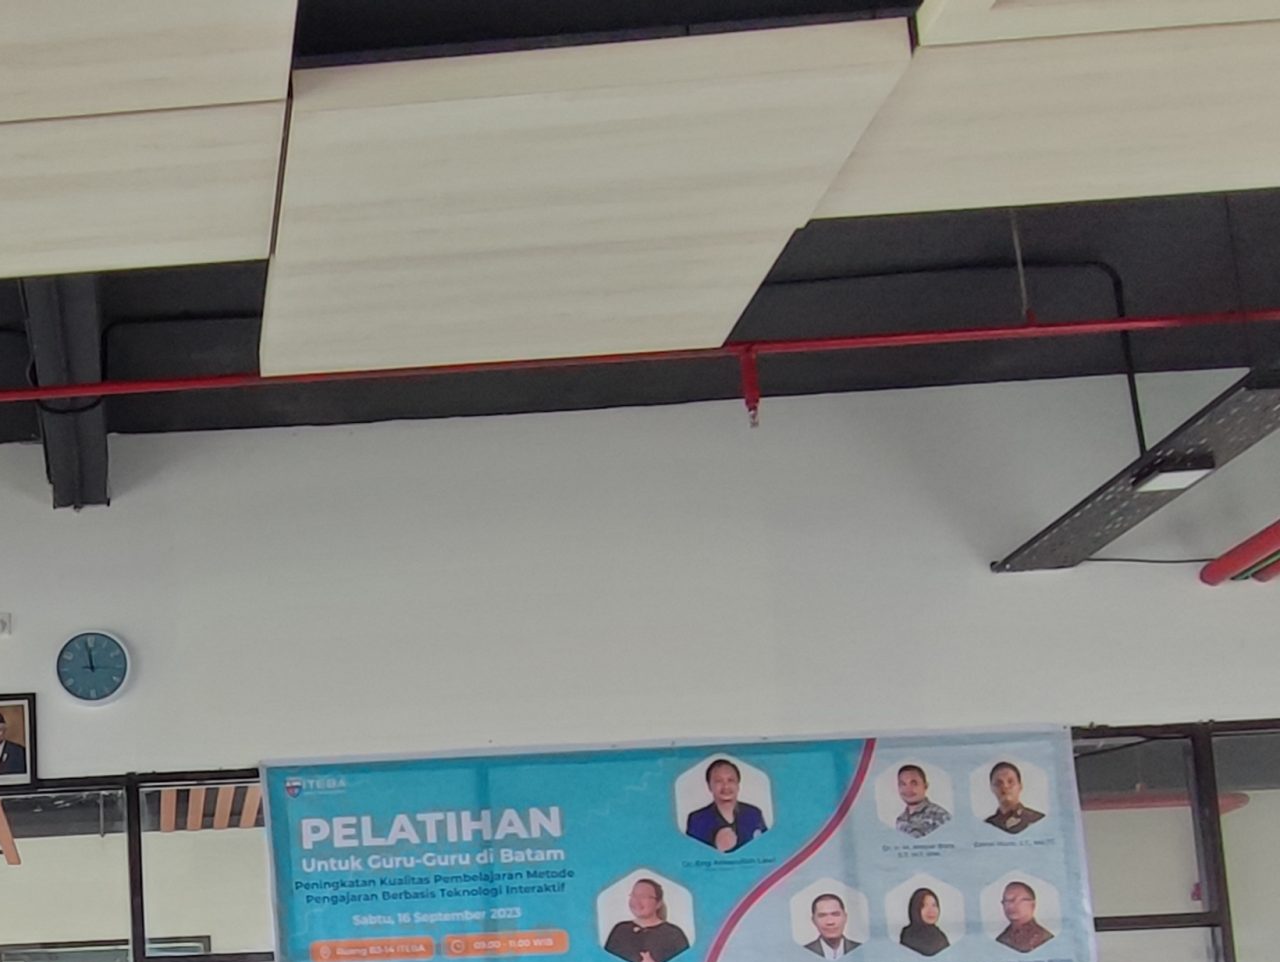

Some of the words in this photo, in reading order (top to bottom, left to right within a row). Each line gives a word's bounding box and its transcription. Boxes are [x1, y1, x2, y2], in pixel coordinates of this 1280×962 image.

[301, 806, 563, 850] PELATIHAN
[302, 855, 362, 873] Untuk
[367, 851, 470, 869] Guru-Guru
[475, 848, 494, 864] di
[500, 847, 565, 863] Batam
[294, 877, 377, 892] Peningkatan
[380, 873, 431, 887] Kualitas
[434, 869, 523, 885] Pembelajaran
[526, 867, 575, 880] Metode
[305, 891, 378, 906] Pengajaran
[382, 888, 437, 901] Berbasis
[440, 885, 503, 899] Teknologi
[506, 882, 566, 894] Interaktif
[352, 913, 395, 926] Sabtu,
[397, 912, 411, 923] 16
[414, 910, 486, 923] September
[490, 906, 522, 919] 2023
